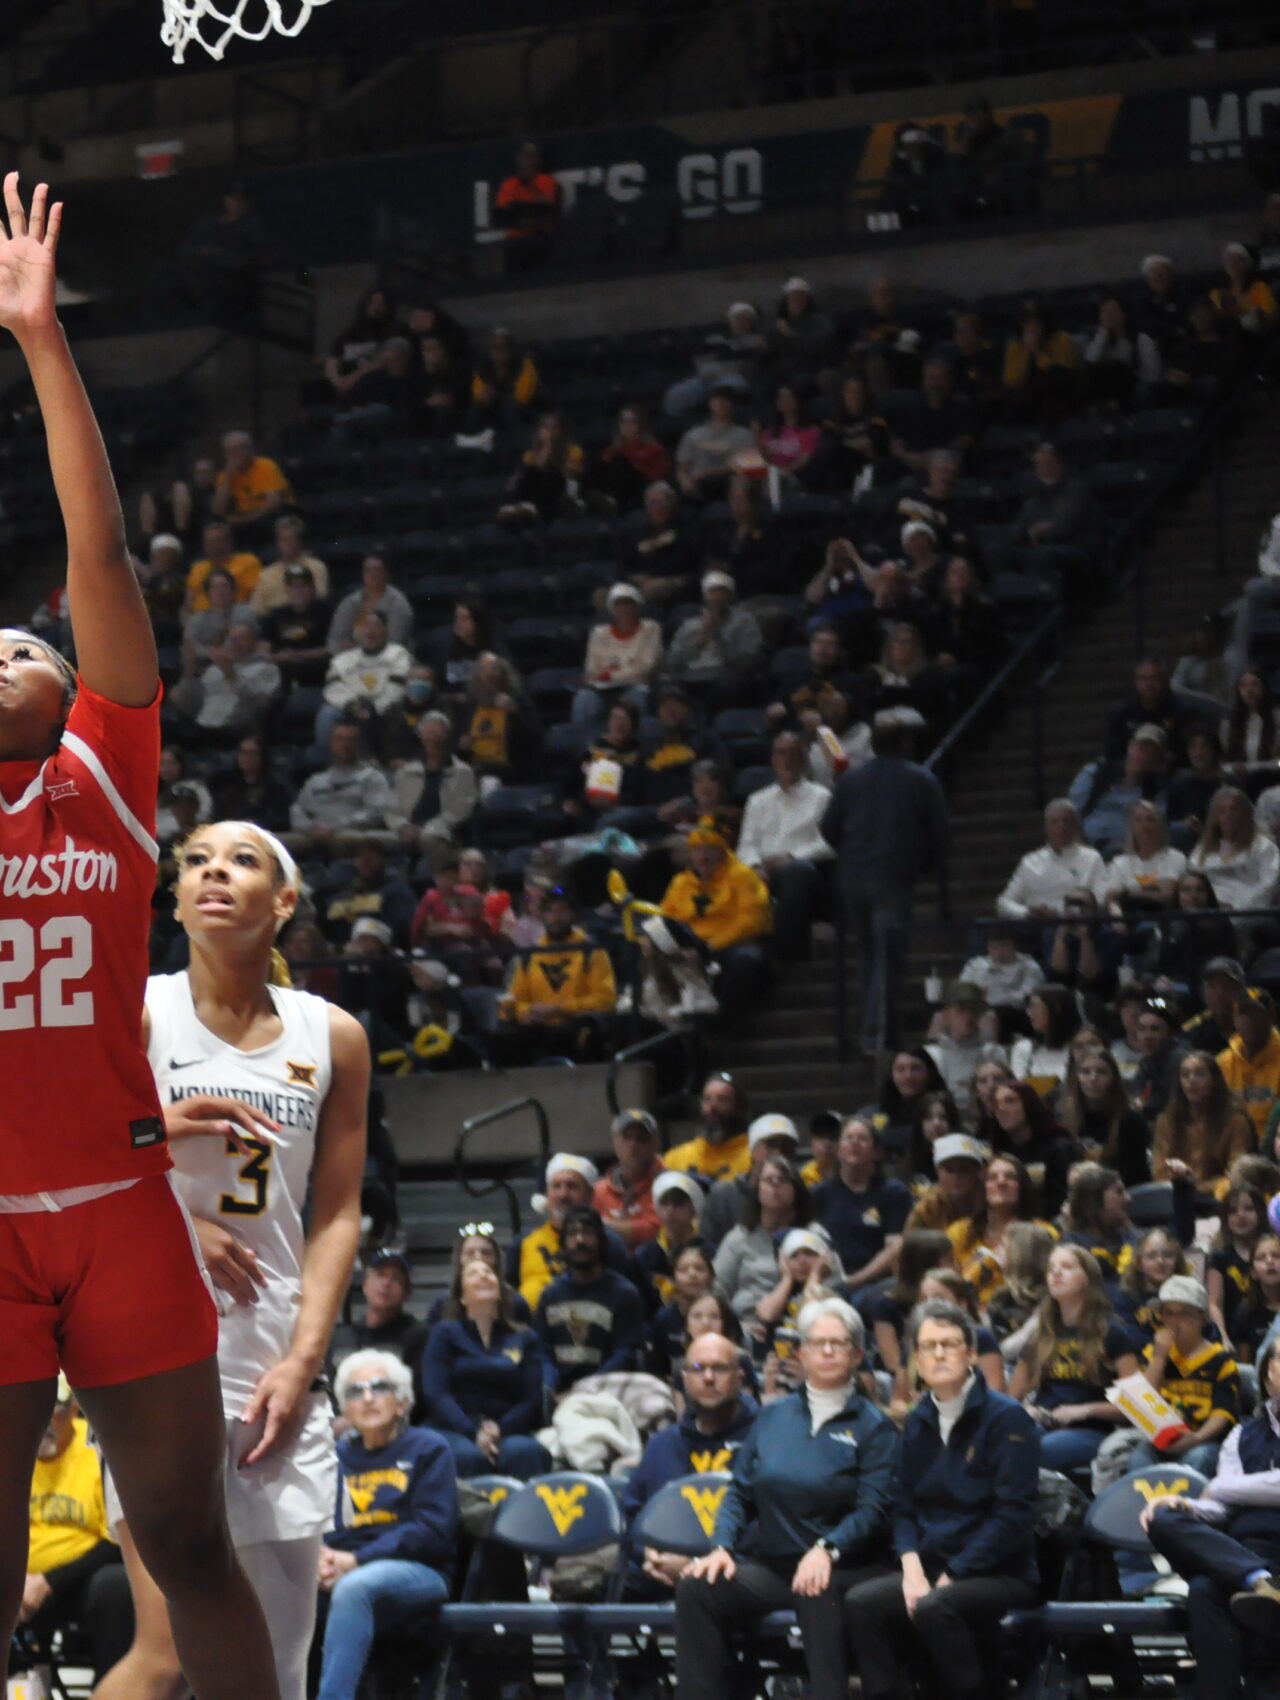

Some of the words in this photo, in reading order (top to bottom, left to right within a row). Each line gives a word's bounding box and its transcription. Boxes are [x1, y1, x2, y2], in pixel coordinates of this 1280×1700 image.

[474, 160, 648, 243] LT'S
[676, 147, 763, 219] GO
[219, 1135, 272, 1216] 3
